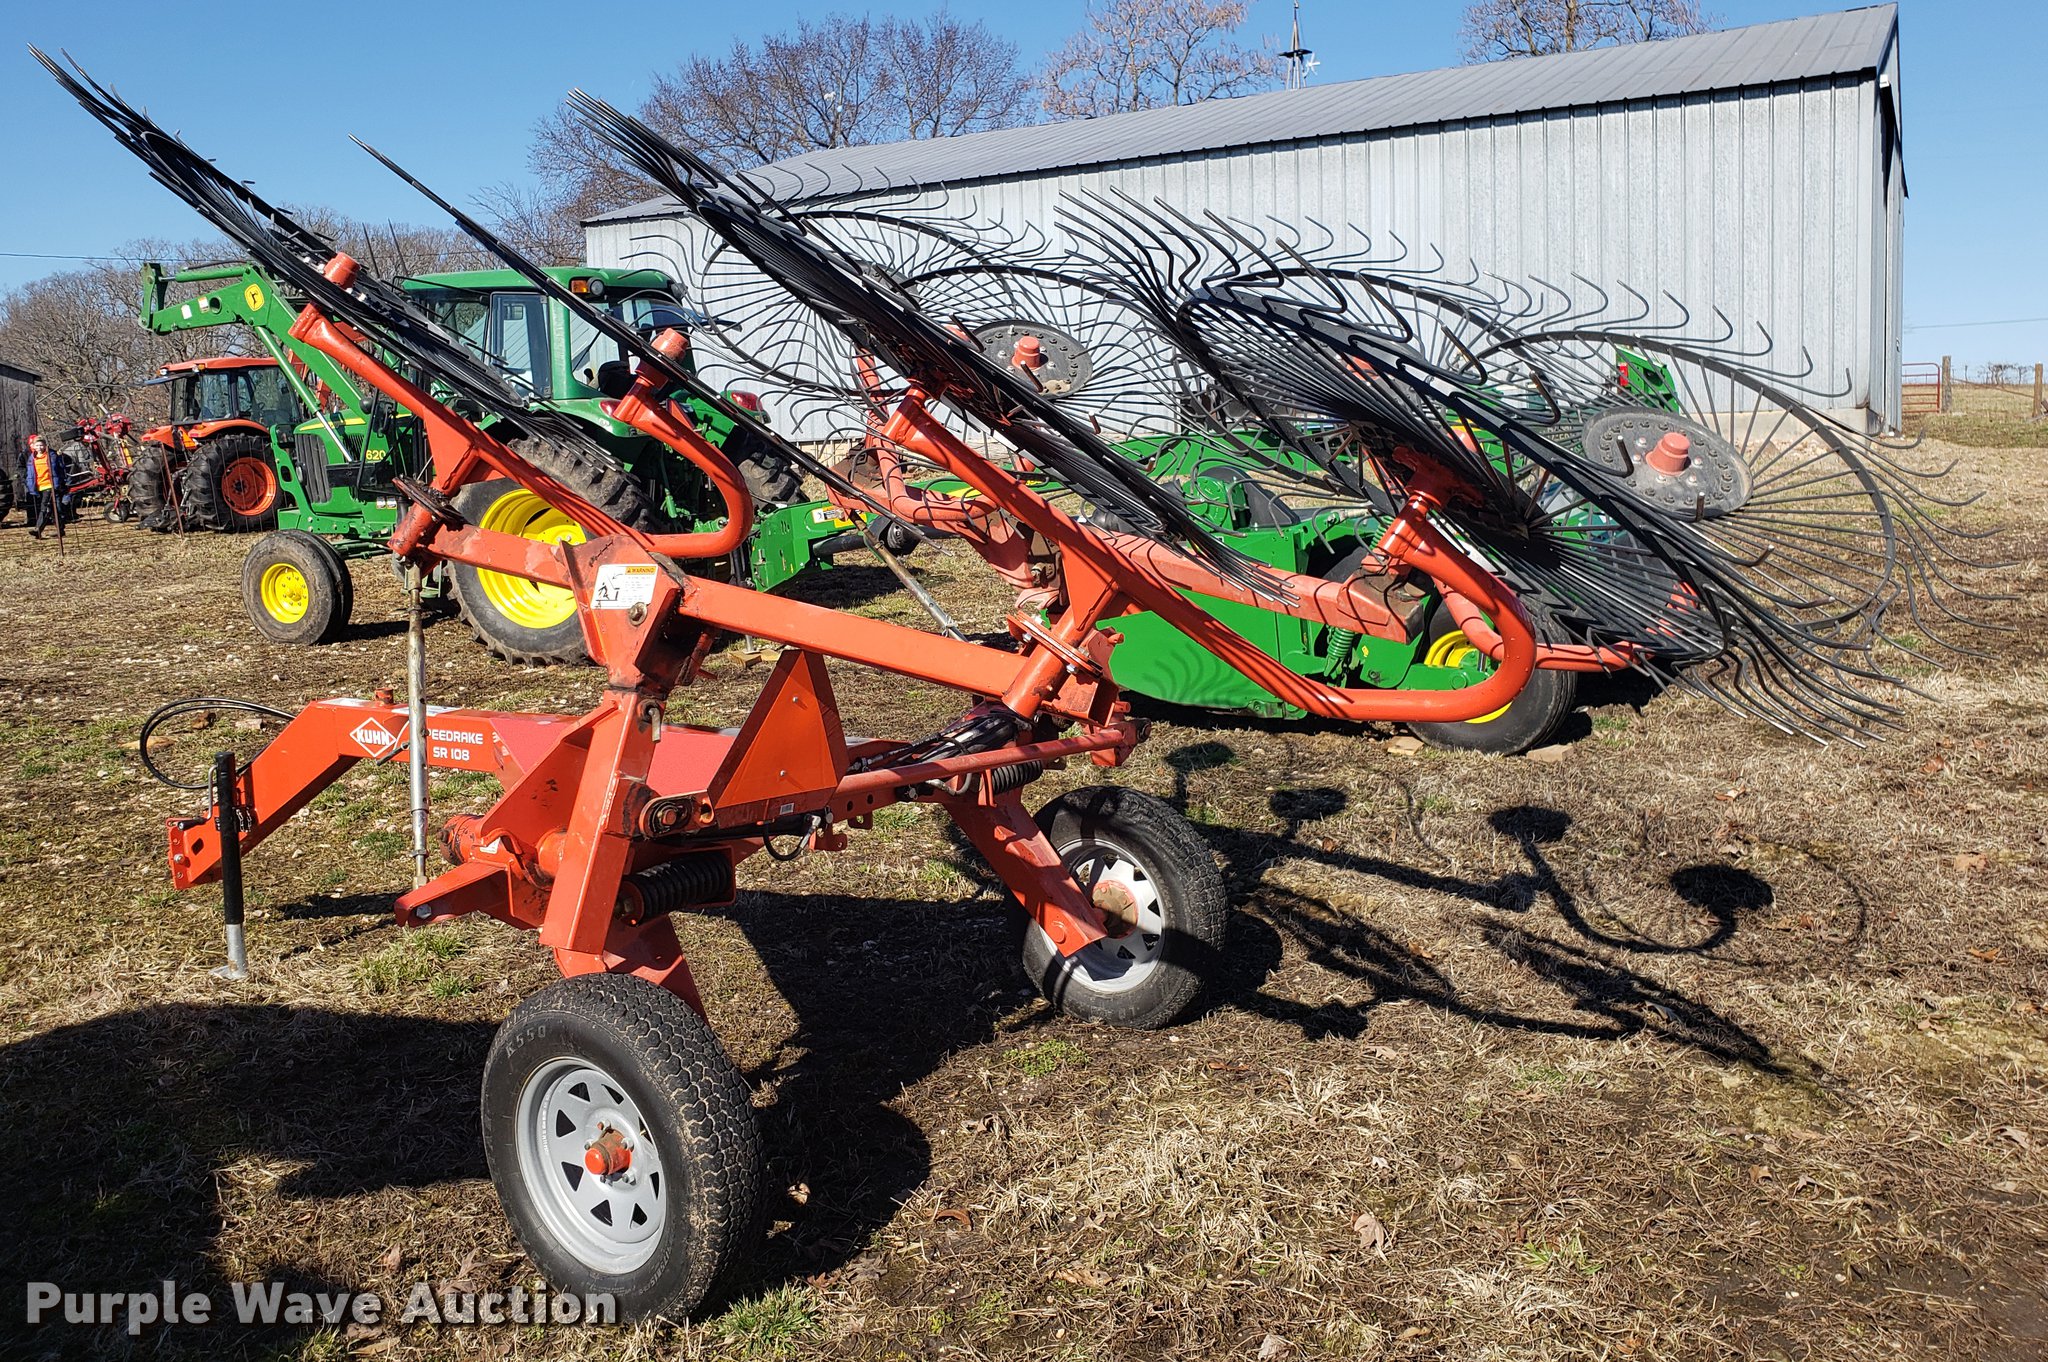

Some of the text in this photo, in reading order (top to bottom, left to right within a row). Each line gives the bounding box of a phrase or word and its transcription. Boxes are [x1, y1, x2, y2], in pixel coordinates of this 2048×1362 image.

[356, 729, 391, 746] KUHN
[432, 746, 470, 761] SR 108
